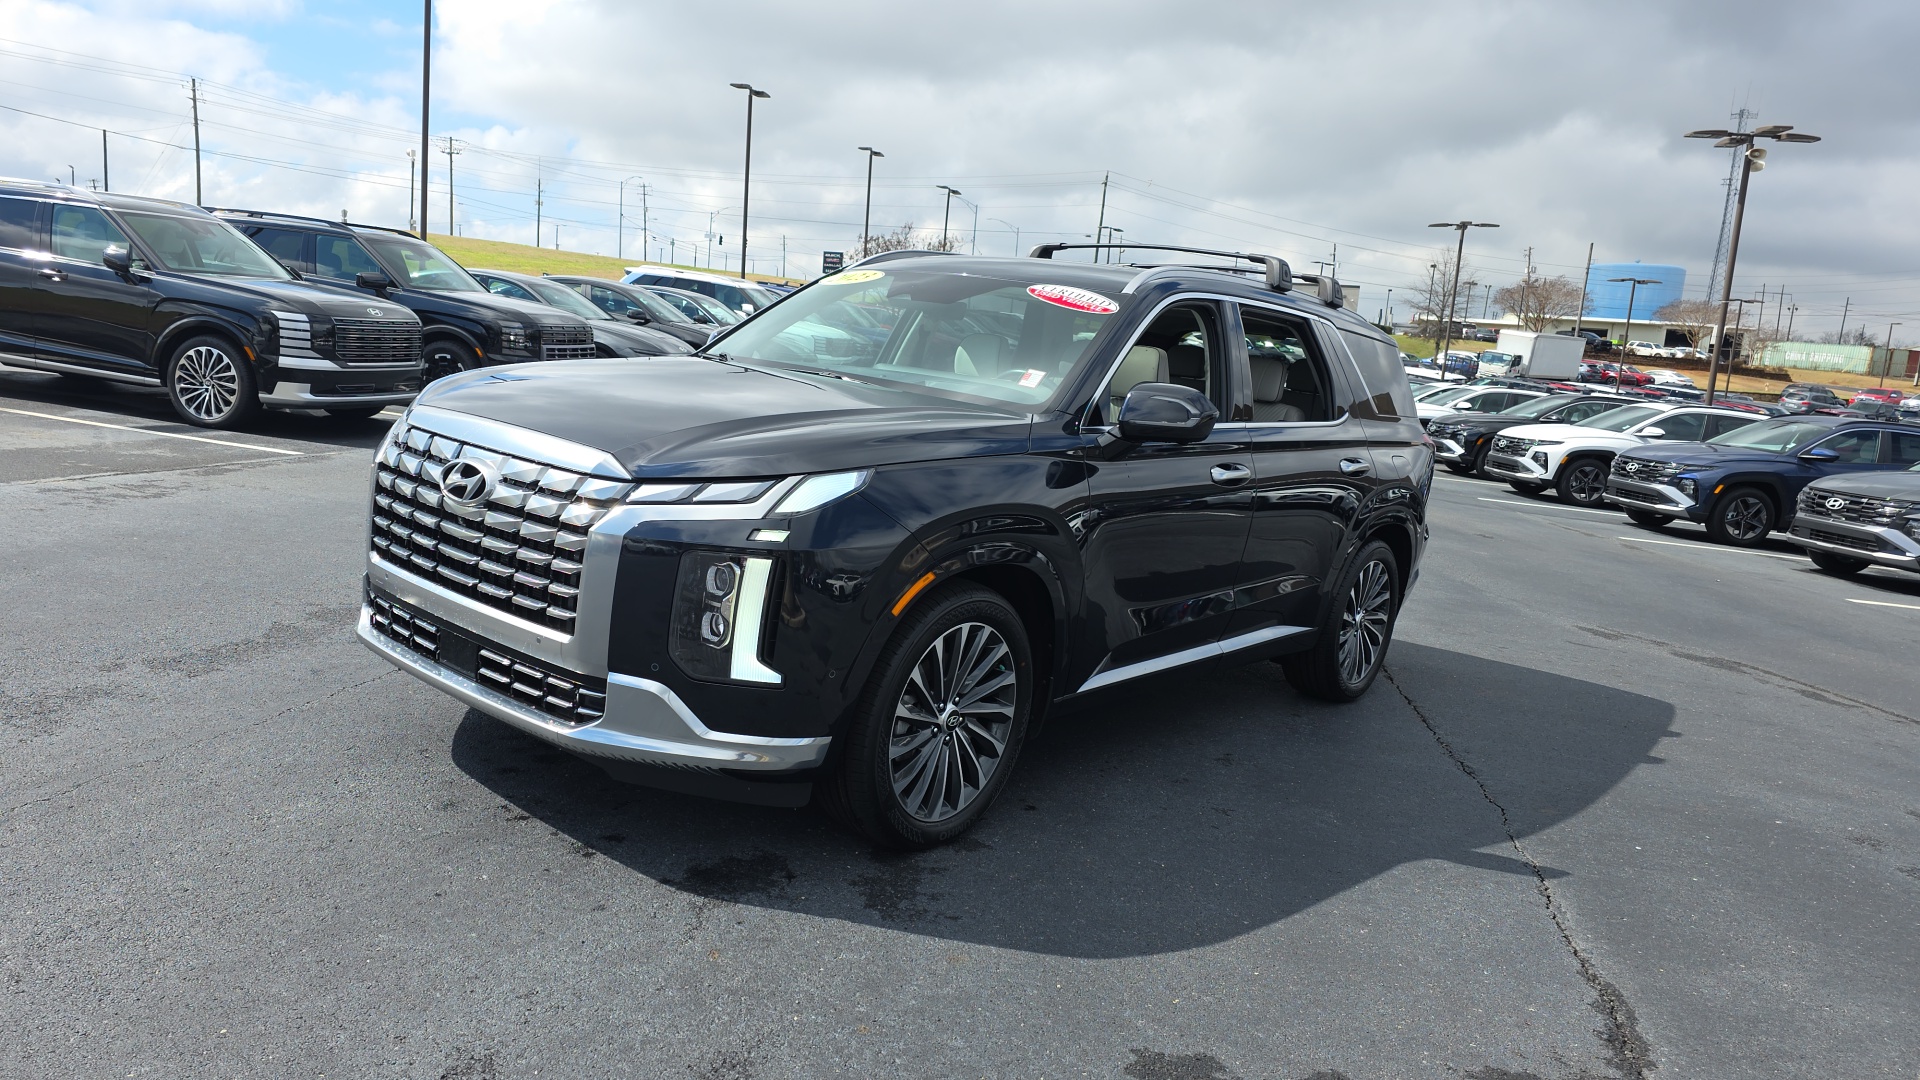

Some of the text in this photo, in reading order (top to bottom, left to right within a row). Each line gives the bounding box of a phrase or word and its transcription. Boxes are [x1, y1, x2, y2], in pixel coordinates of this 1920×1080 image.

[1034, 289, 1104, 312] USED VEHICLE
[1785, 350, 1806, 361] CHINA
[1809, 351, 1845, 364] SHIPPING
